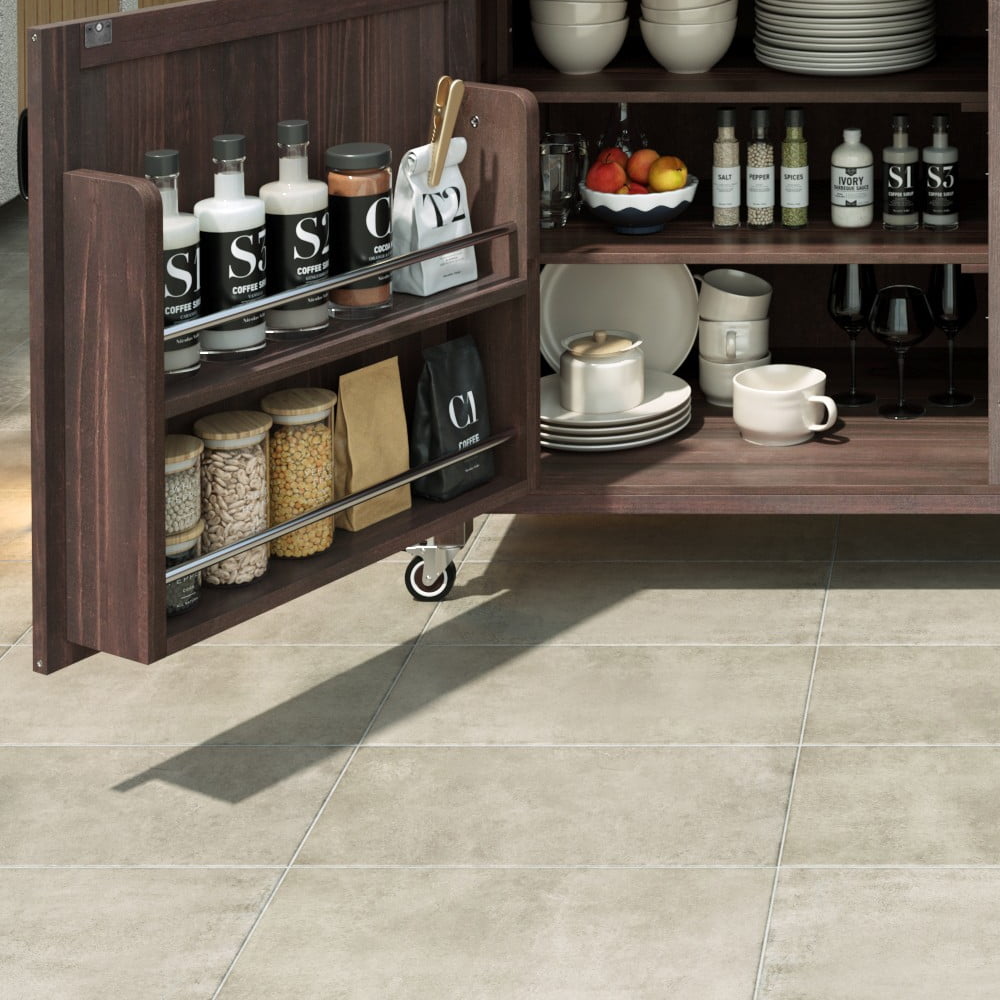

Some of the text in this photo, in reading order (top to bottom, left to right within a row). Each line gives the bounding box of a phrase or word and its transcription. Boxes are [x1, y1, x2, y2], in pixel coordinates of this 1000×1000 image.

[749, 173, 770, 181] PEPPER
[783, 173, 804, 181] SPICES
[838, 176, 864, 186] IVORY
[888, 165, 914, 189] S1
[422, 186, 466, 230] T2
[296, 263, 322, 276] COFFEE
[232, 282, 259, 295] COFFEE
[164, 302, 192, 315] COFFEE
[448, 390, 479, 429] C1
[458, 433, 481, 452] COFFEE
